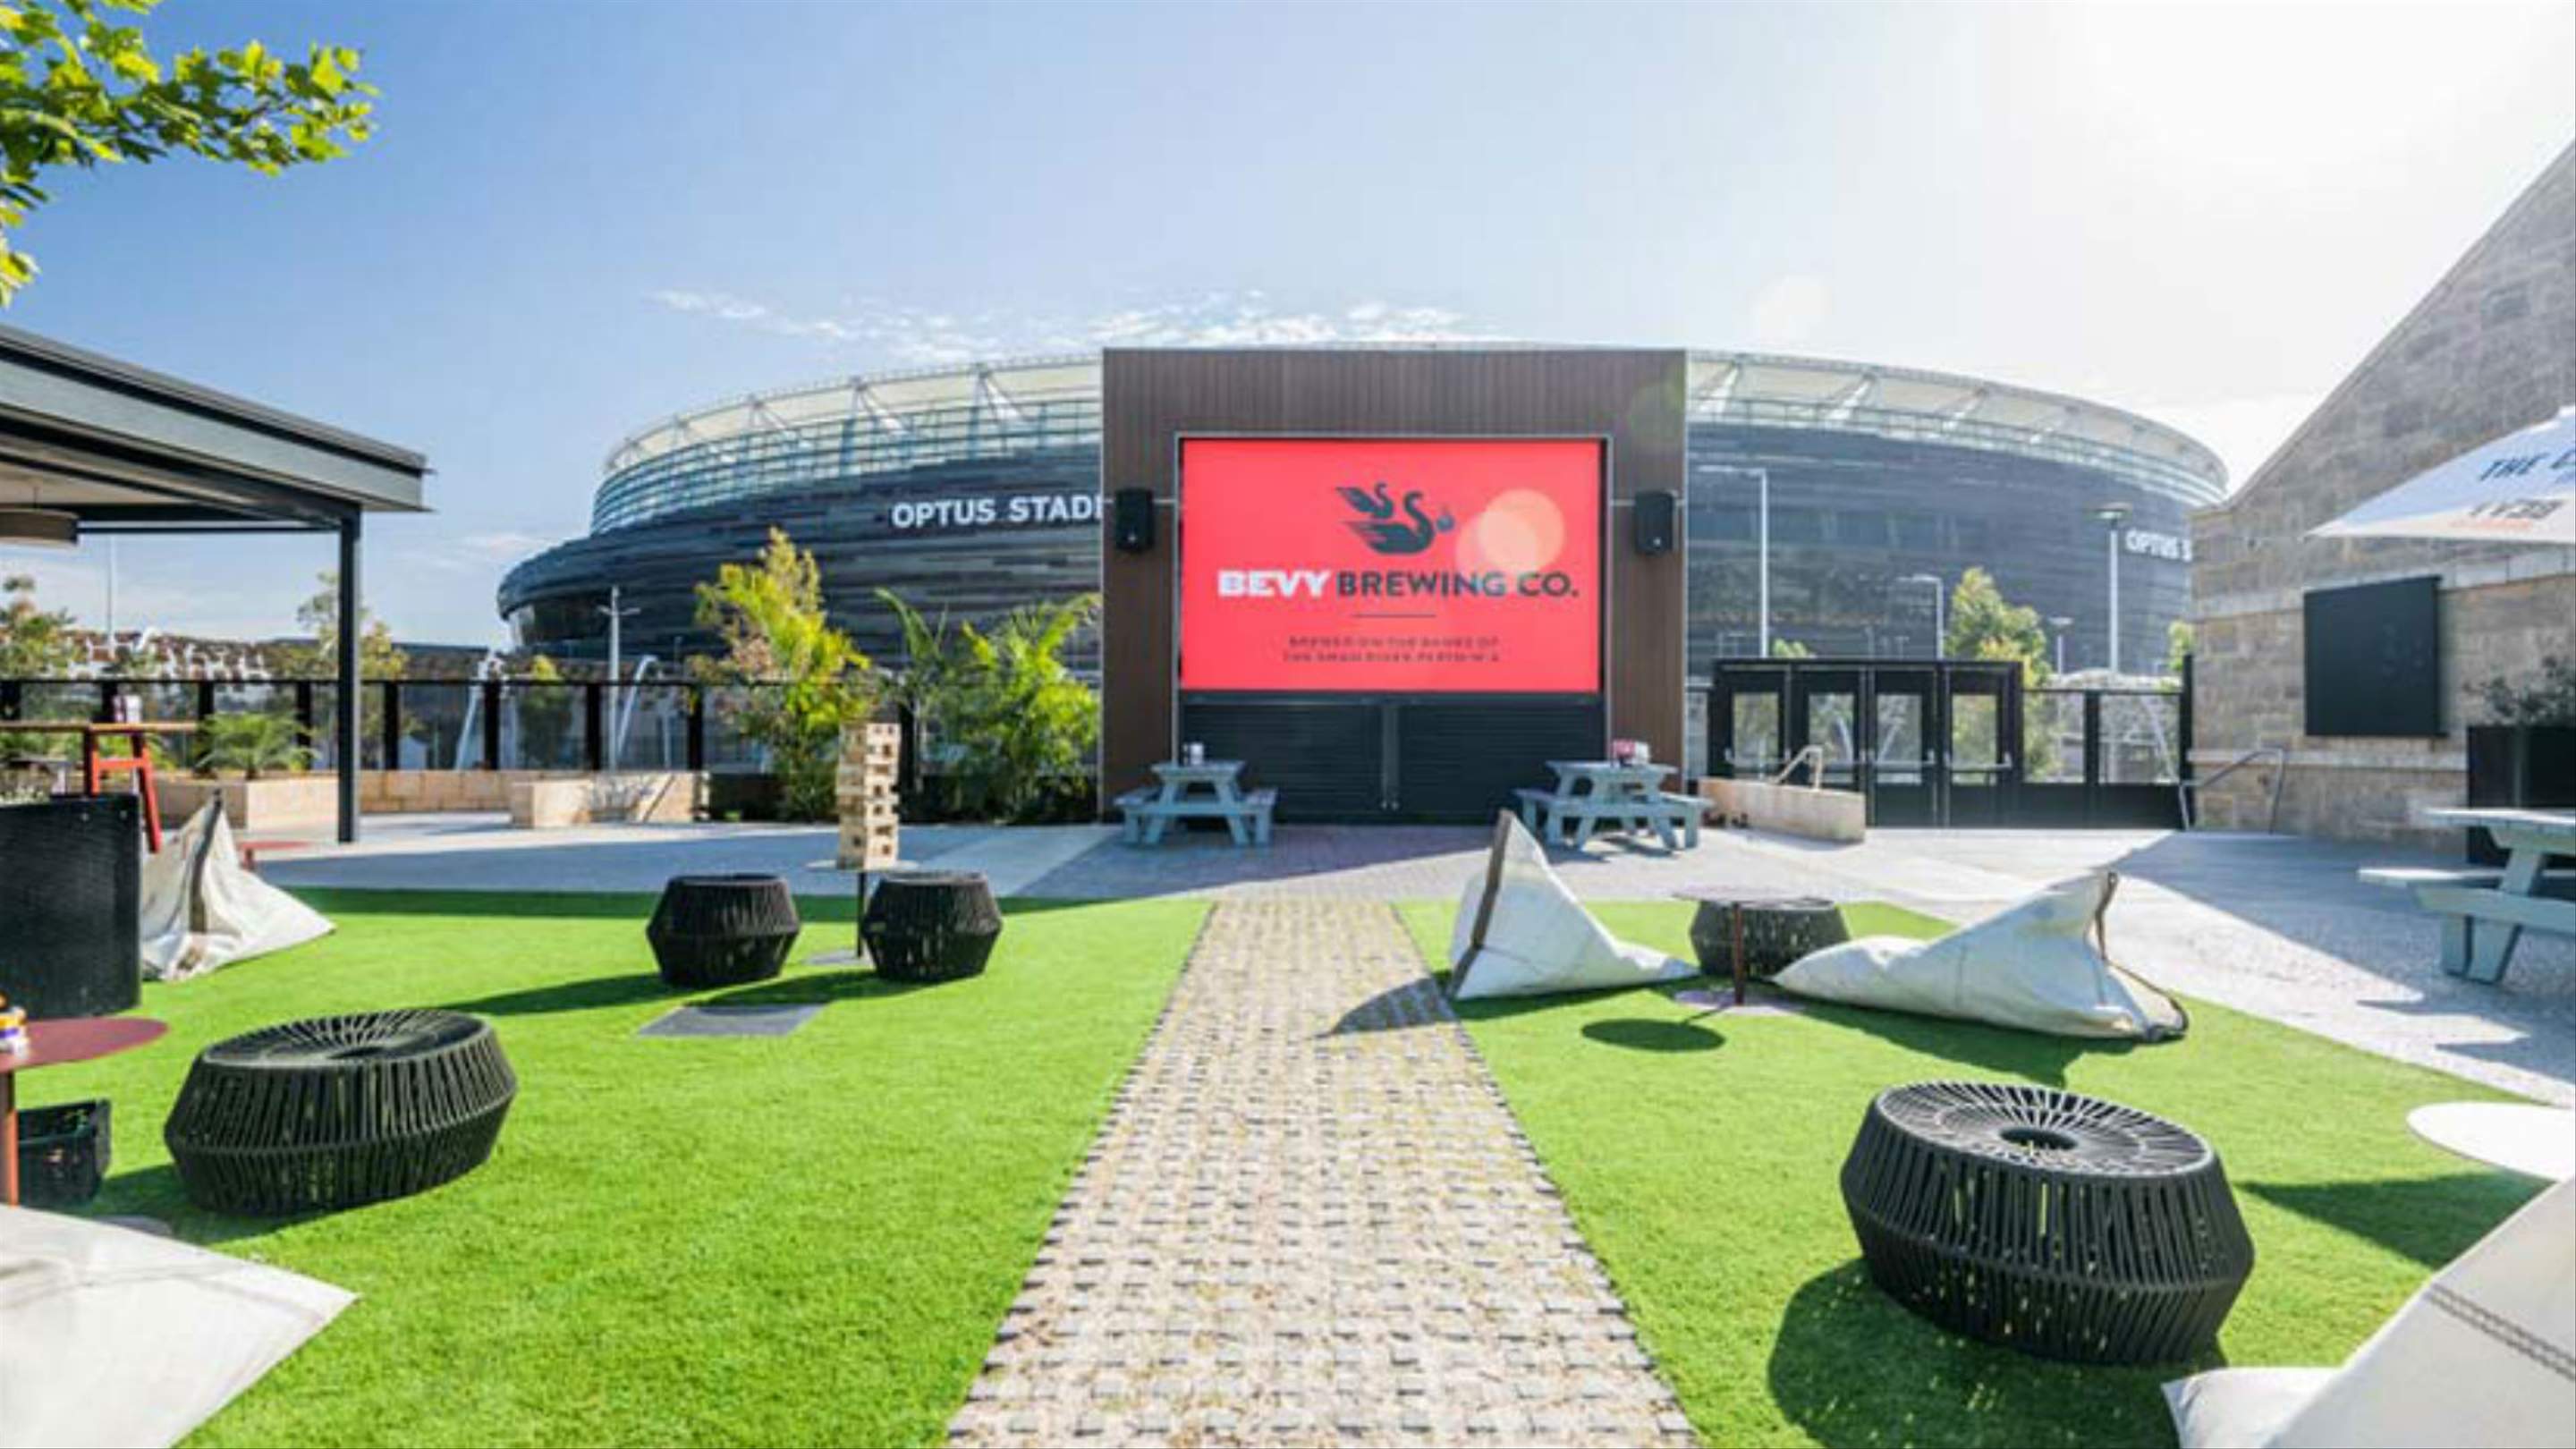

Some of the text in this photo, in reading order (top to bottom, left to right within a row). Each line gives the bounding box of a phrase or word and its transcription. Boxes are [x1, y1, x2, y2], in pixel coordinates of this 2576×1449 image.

[891, 498, 996, 529] OPTUS
[1217, 568, 1579, 598] BEVY BREWING CO.
